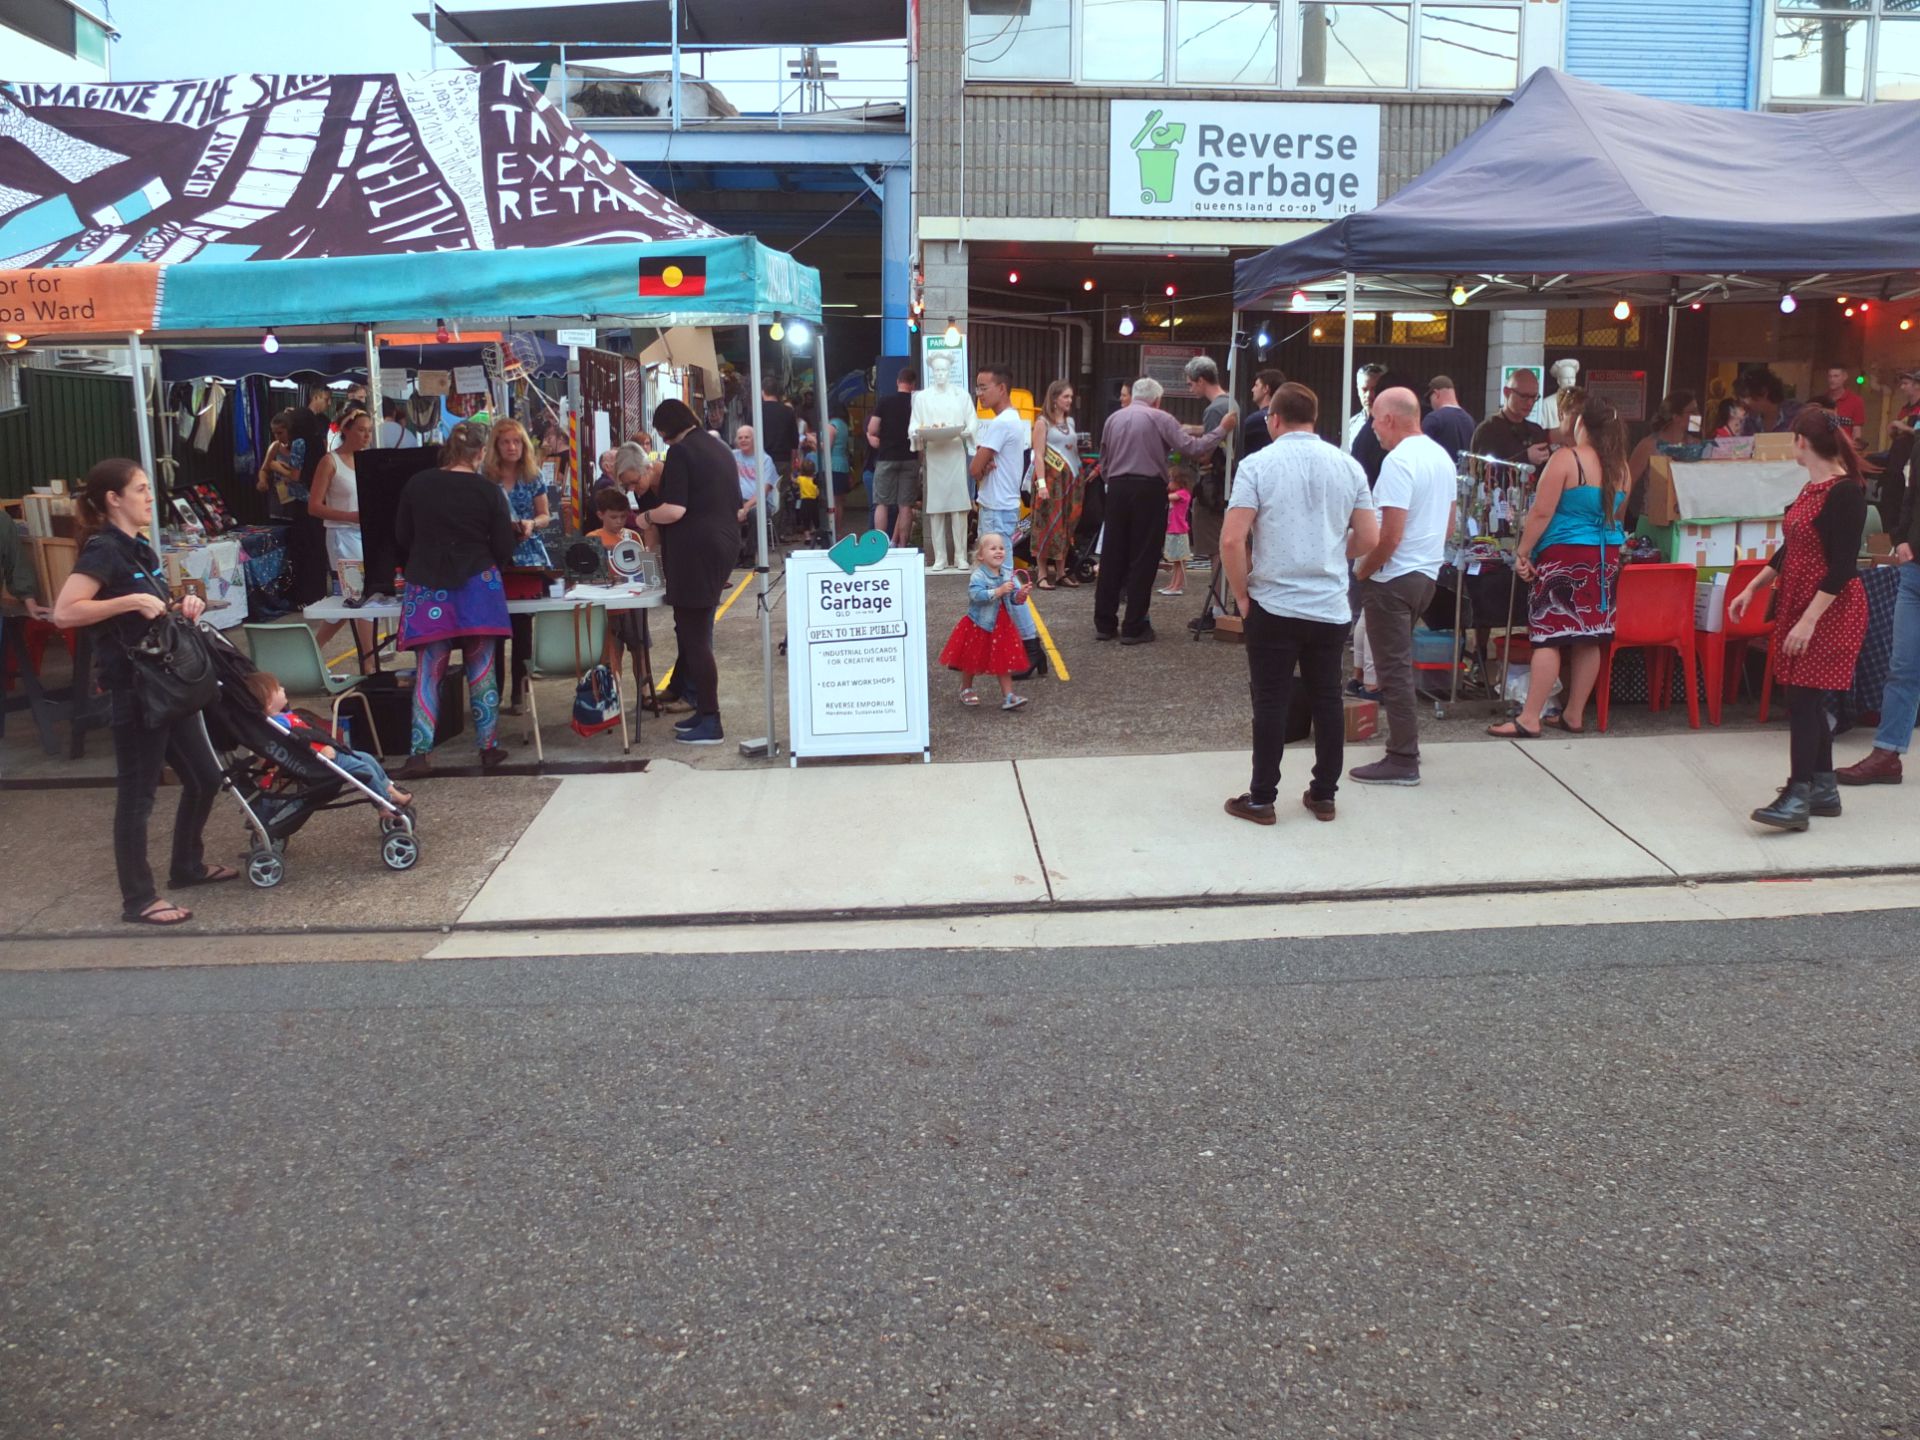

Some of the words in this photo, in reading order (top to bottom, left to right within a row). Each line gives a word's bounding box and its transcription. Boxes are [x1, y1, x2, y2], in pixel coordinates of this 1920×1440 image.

[162, 74, 237, 126] THE
[1199, 124, 1357, 160] Reverse
[183, 131, 237, 195] LIBRARY
[1194, 163, 1358, 205] Garbage
[1195, 202, 1272, 212] queensland
[1280, 203, 1316, 213] co-op
[1338, 204, 1356, 213] ltd
[27, 272, 61, 293] for
[32, 298, 94, 320] Ward
[820, 579, 890, 594] Reverse
[820, 595, 892, 613] Garbage
[810, 630, 833, 639] OPEN
[836, 628, 847, 638] TO
[849, 626, 867, 637] THE
[870, 624, 900, 635] PUBLIC
[852, 677, 895, 686] WORKSHOPS
